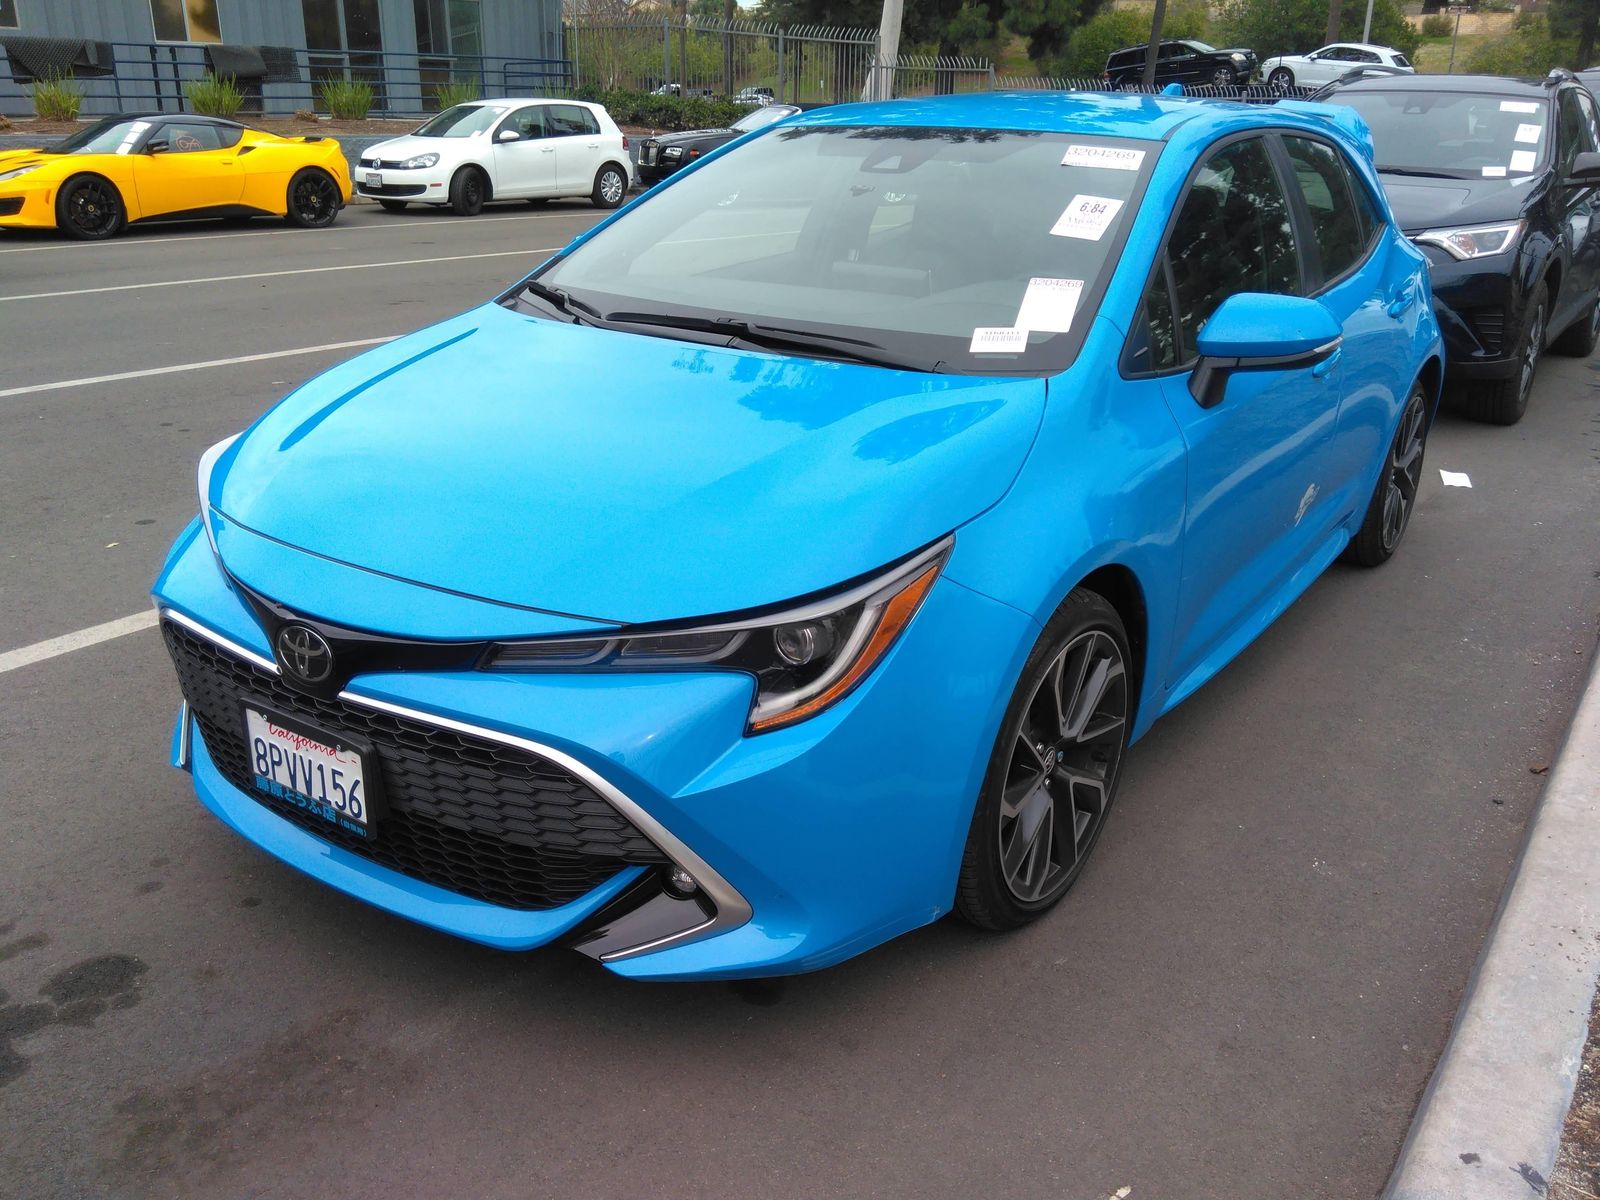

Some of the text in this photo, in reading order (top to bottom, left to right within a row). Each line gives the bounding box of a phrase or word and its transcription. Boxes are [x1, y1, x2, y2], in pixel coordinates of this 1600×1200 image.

[1067, 146, 1137, 160] 3204269
[1030, 278, 1084, 288] 3204269
[253, 736, 363, 820] 8PVV156
